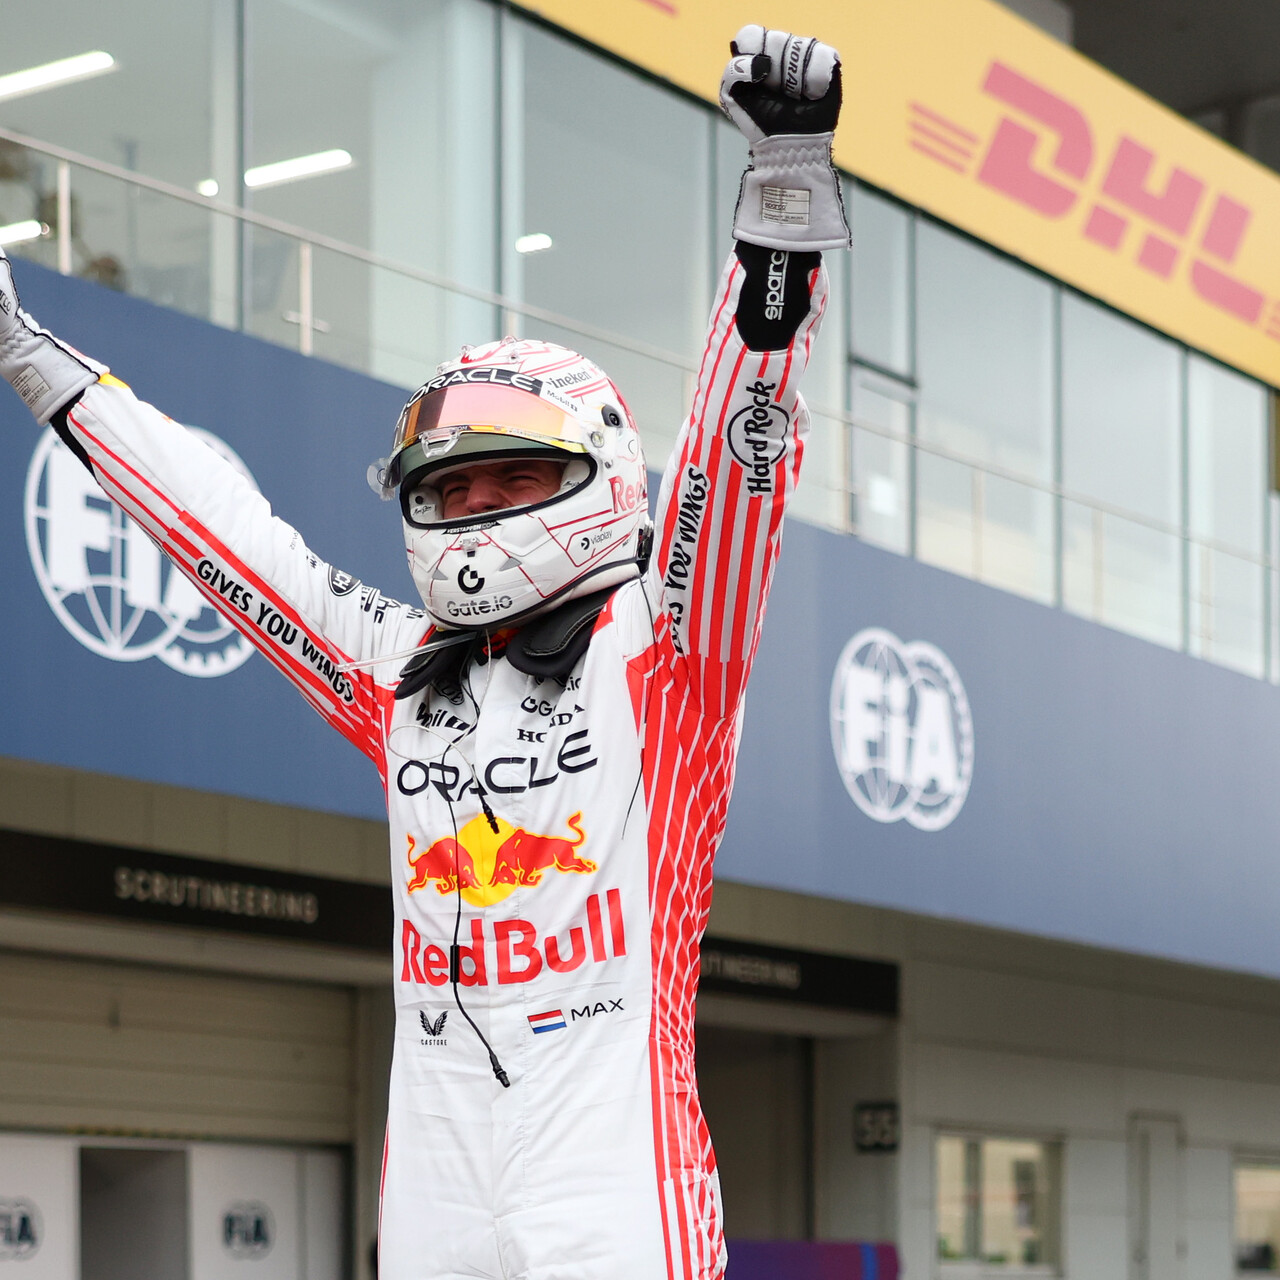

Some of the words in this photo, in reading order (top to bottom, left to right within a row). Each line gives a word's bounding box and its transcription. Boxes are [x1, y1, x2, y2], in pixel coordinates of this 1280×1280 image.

[975, 59, 1267, 328] DHL
[765, 252, 787, 320] sparc
[407, 367, 536, 407] ORACLE
[745, 381, 776, 436] Rock
[745, 438, 772, 493] Hard
[678, 467, 710, 546] WINGS
[665, 536, 693, 592] YOU
[197, 559, 251, 612] GIVES
[257, 605, 295, 647] YOU
[302, 638, 355, 703] WINGS
[446, 594, 514, 618] Gate.io
[842, 664, 960, 795] FIA
[397, 729, 598, 802] ORACLE
[114, 868, 320, 925] SCRUTINEERING
[401, 919, 487, 988] Red
[494, 887, 627, 986] Bull
[571, 996, 626, 1022] MAX
[420, 1038, 448, 1047] CASTORE
[224, 1210, 268, 1248] FIA
